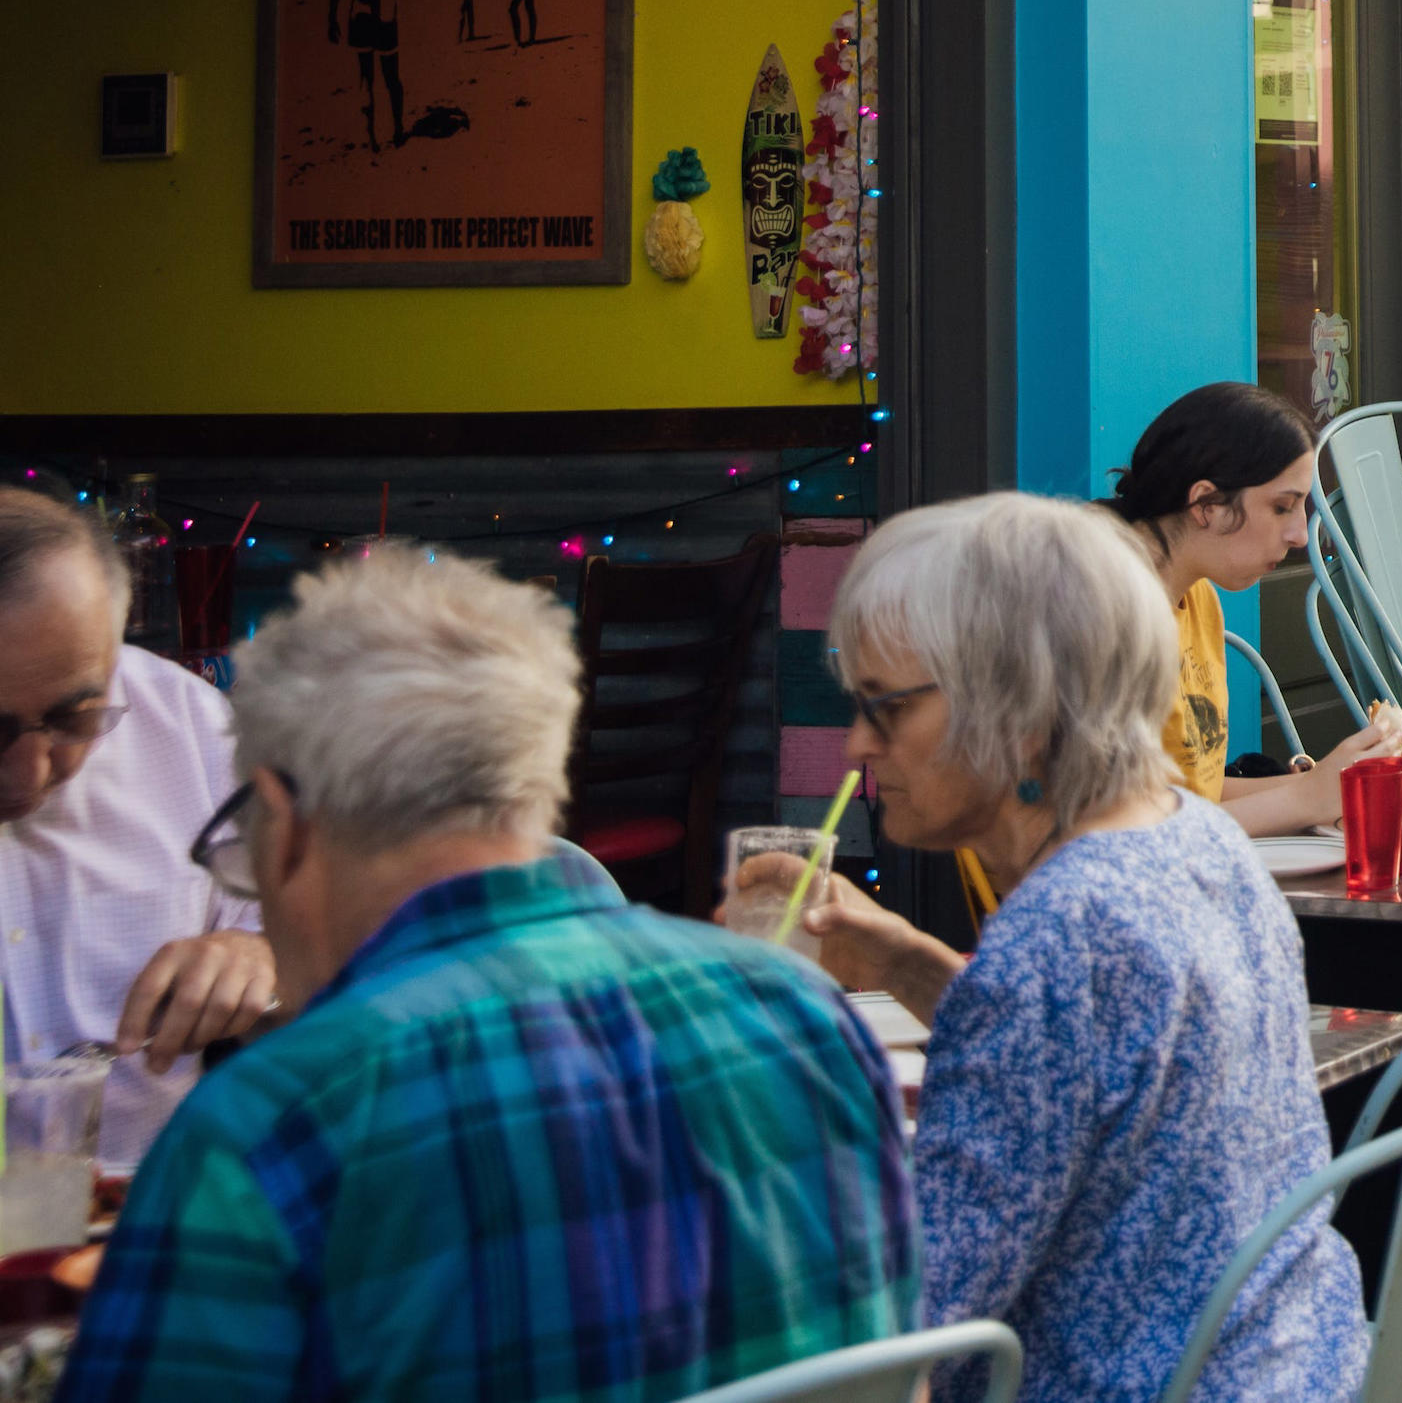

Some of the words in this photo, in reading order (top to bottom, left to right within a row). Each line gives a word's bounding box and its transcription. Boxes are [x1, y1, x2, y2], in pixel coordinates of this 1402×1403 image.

[750, 110, 797, 137] TIKI
[289, 220, 320, 250] THE
[323, 219, 391, 250] SEARCH
[395, 218, 426, 249] FOR
[431, 218, 462, 249] THE
[467, 217, 540, 248] PERFECT
[543, 216, 594, 247] WAVE
[752, 250, 797, 286] Bar
